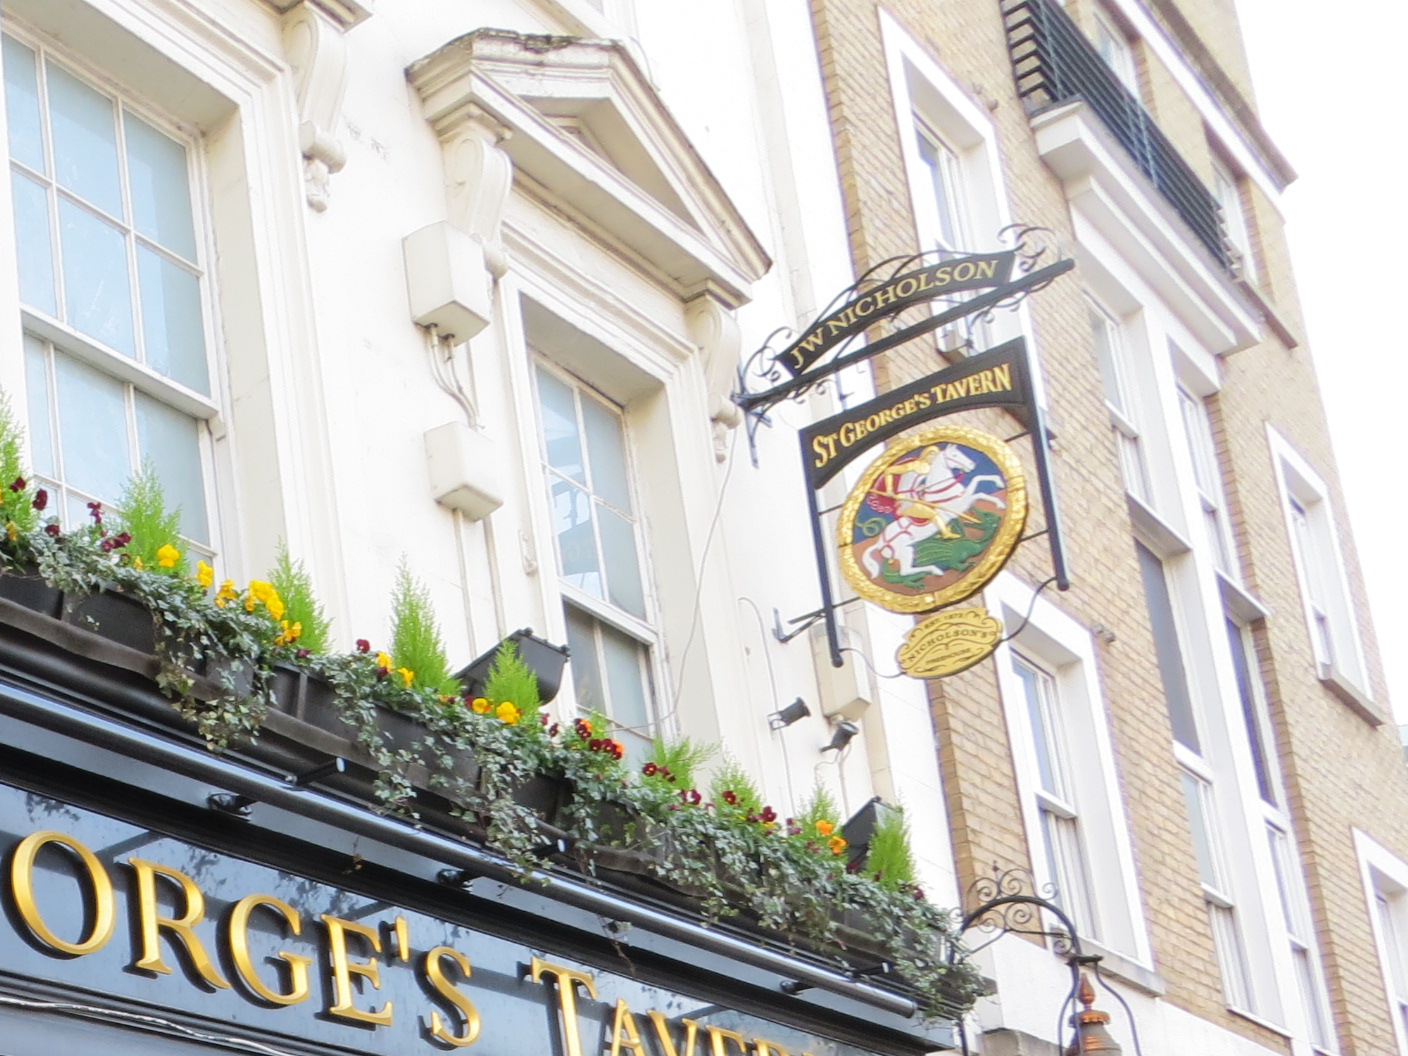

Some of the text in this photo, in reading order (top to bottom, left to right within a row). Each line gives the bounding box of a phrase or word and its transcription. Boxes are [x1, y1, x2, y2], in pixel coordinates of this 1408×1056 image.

[825, 259, 999, 338] NICHOLSON
[813, 363, 1014, 468] ST GEORGE'S TAVERN
